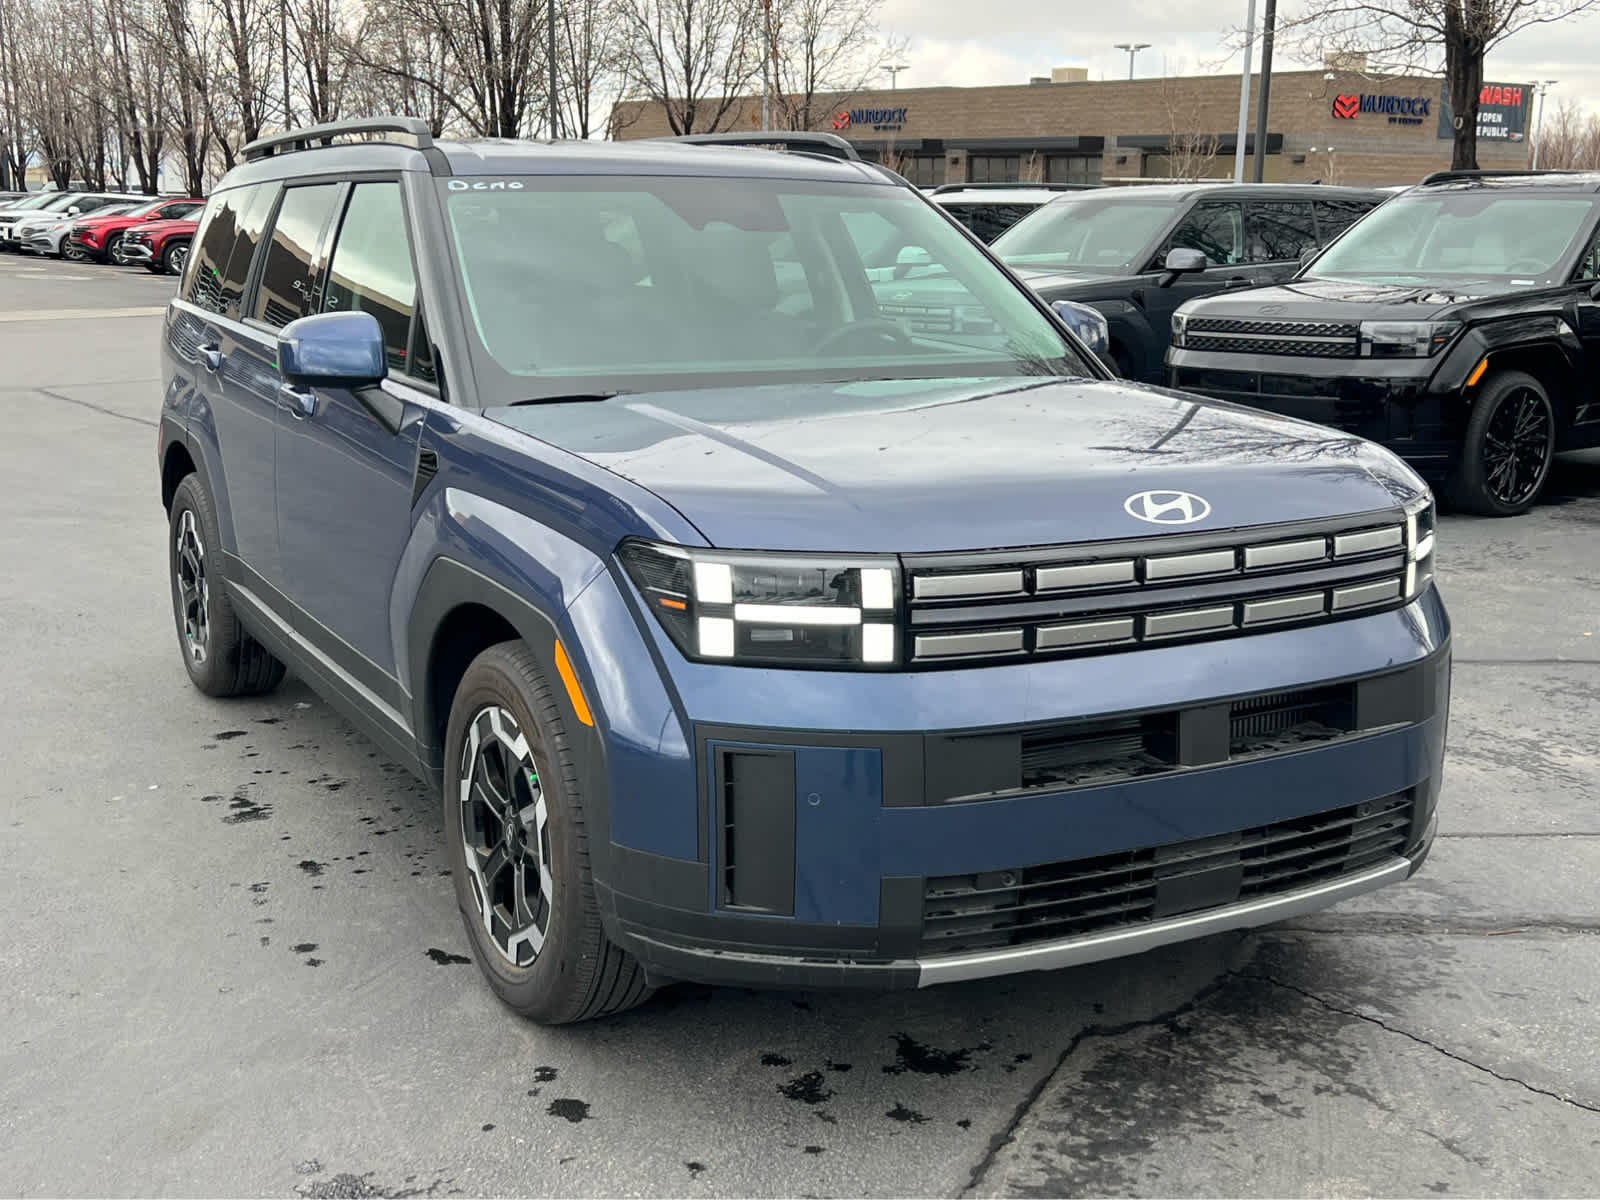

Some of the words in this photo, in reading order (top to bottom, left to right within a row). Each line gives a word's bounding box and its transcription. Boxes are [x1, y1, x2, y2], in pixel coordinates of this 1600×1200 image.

[1360, 94, 1431, 116] MURDOCK
[851, 108, 908, 124] MURDOCK
[1483, 112, 1503, 123] OPEN
[1482, 126, 1508, 137] PUBLIC
